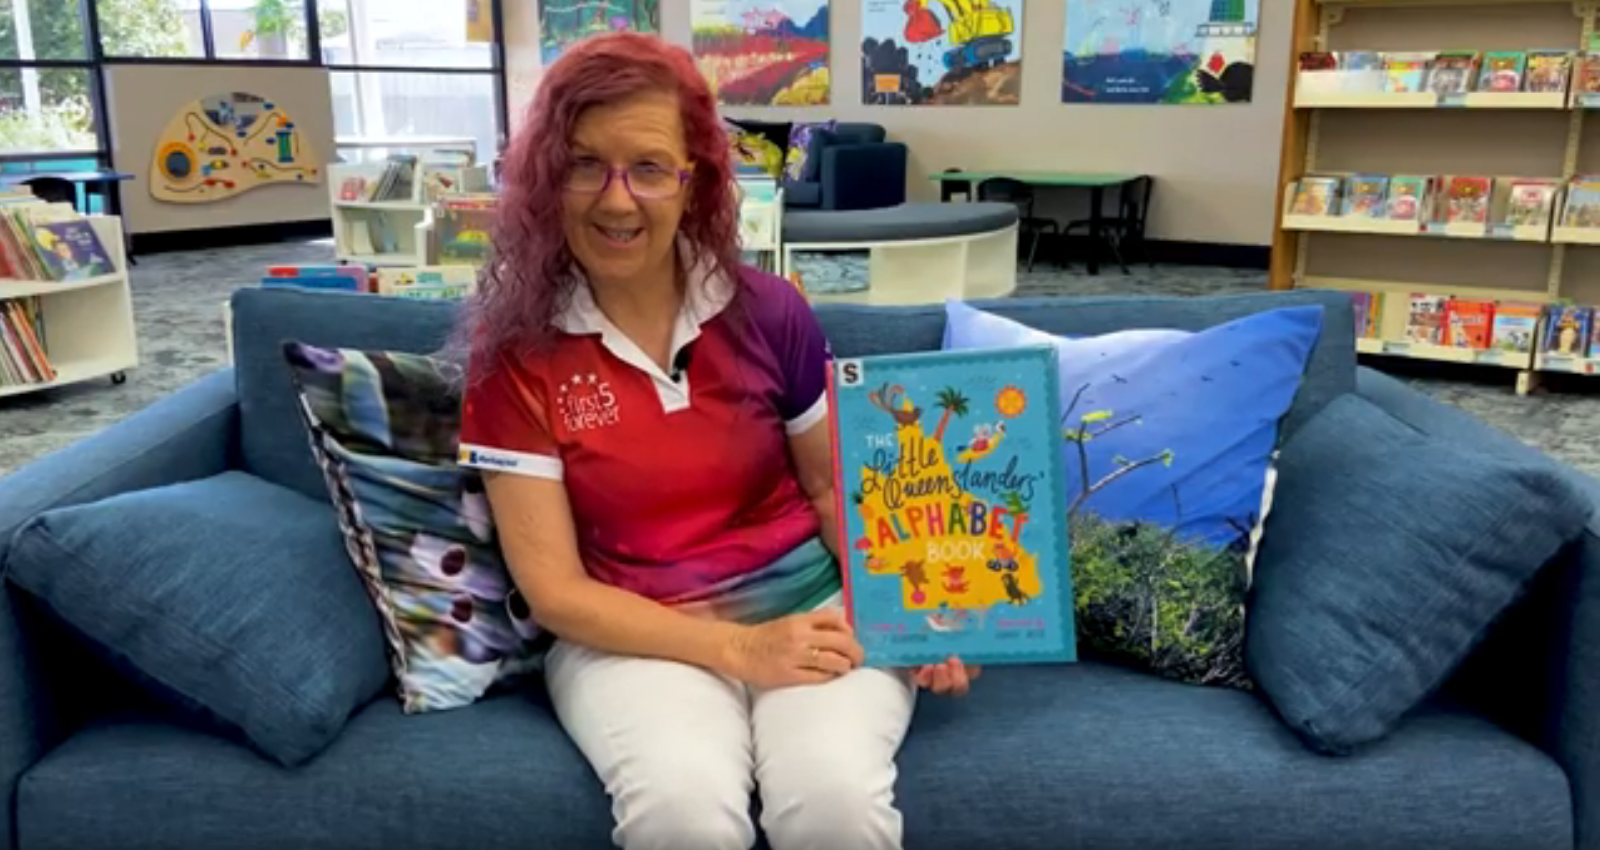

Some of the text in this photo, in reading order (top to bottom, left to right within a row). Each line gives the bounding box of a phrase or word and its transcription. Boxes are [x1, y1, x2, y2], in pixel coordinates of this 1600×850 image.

[843, 363, 859, 383] S
[598, 382, 616, 407] 5
[866, 433, 893, 448] THE
[861, 436, 939, 494] Little
[877, 502, 1029, 548] ALPHABET
[926, 541, 985, 563] BOOK
